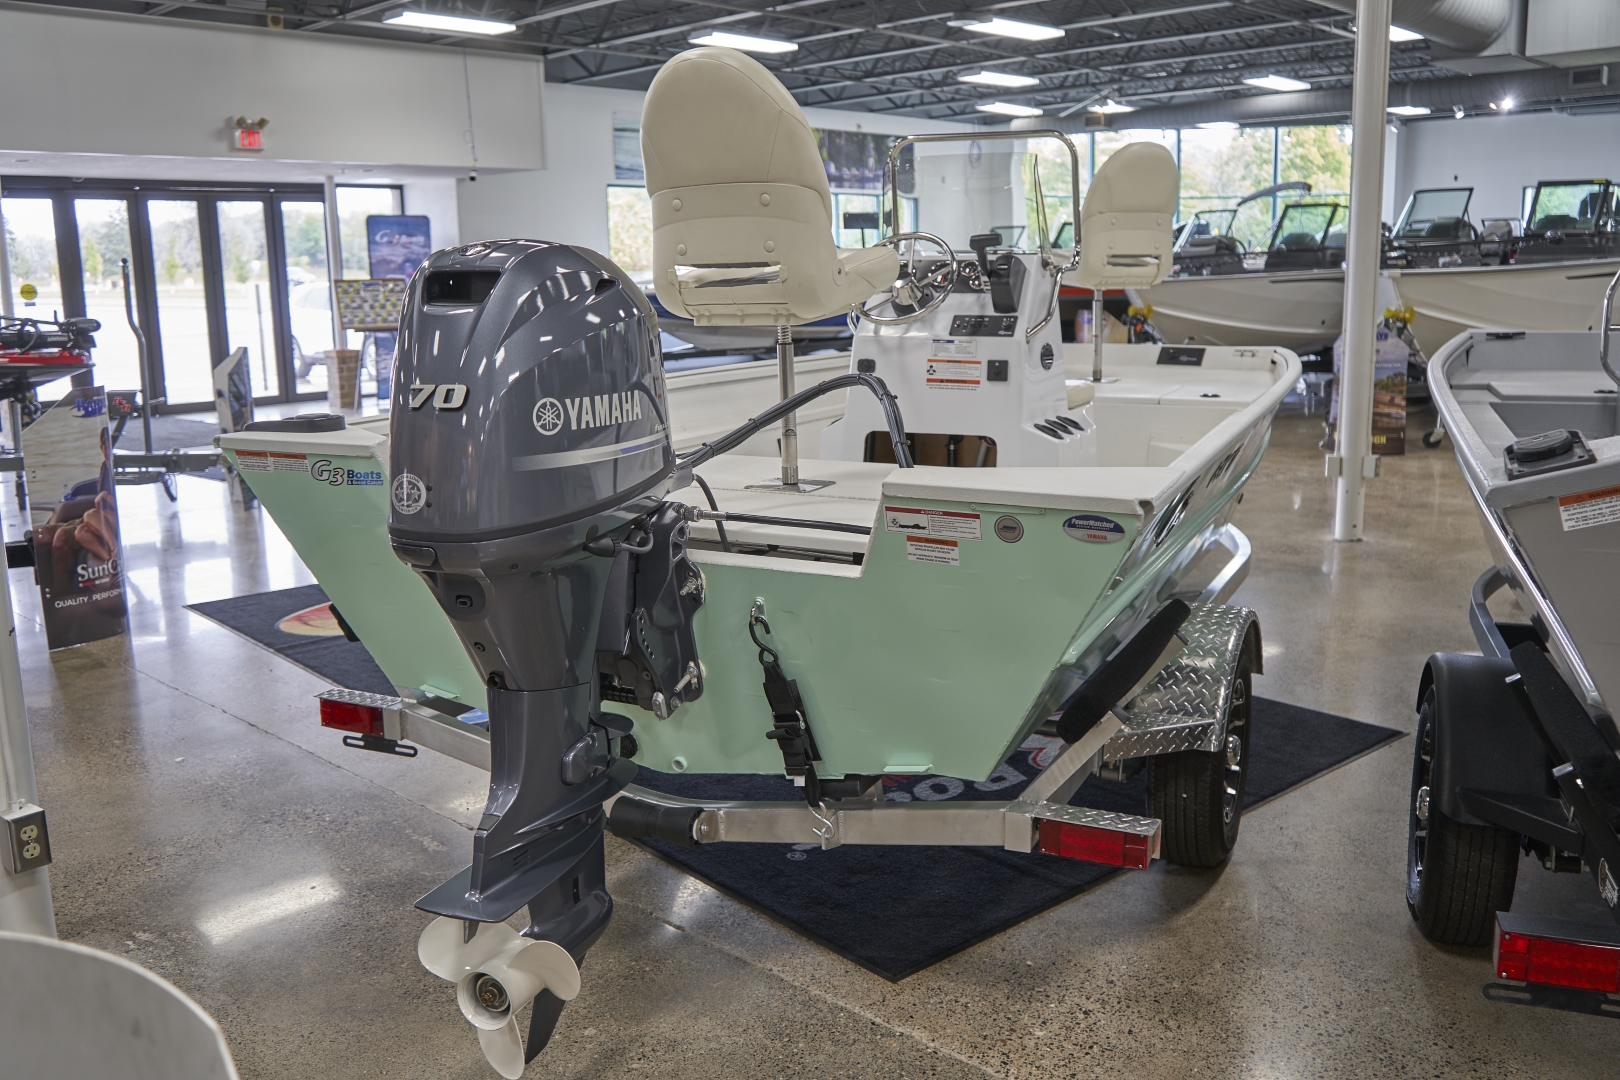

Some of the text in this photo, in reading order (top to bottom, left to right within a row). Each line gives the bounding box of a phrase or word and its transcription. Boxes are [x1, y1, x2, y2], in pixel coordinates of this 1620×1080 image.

[240, 130, 261, 147] EXIT
[409, 384, 468, 409] 70
[564, 389, 643, 430] YAMAHA
[310, 460, 345, 486] G3
[346, 470, 382, 480] Boats
[1589, 488, 1620, 499] WARNIN
[1071, 518, 1116, 529] PowerMatched
[1086, 533, 1108, 541] YAMAHA
[54, 596, 88, 608] QUALITY
